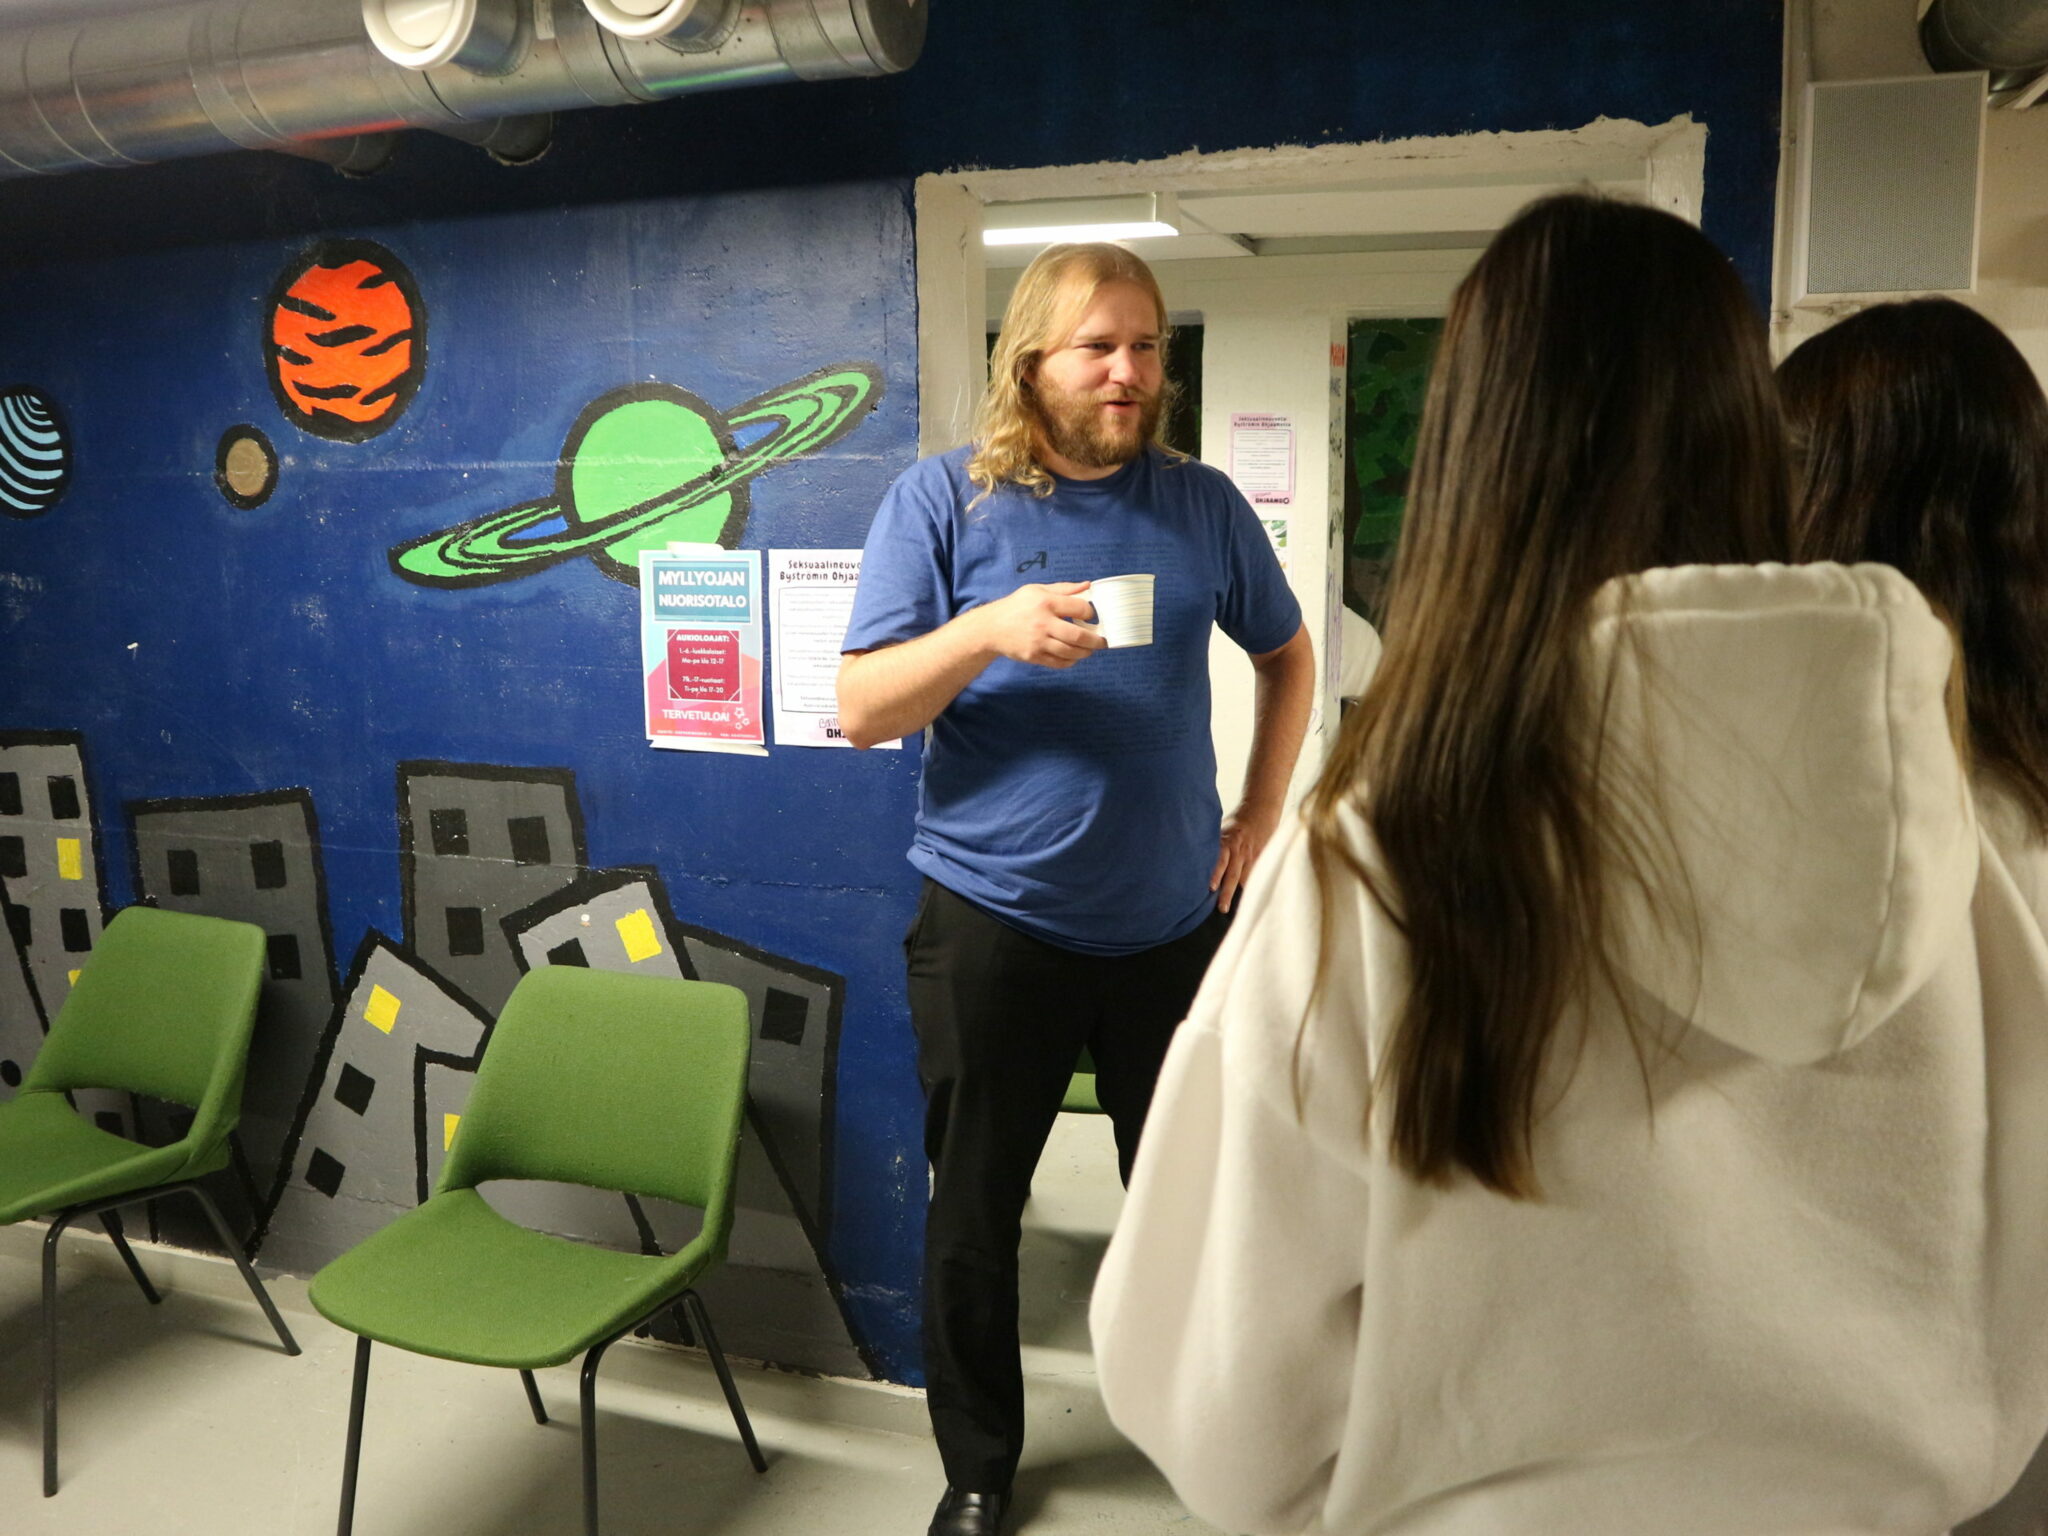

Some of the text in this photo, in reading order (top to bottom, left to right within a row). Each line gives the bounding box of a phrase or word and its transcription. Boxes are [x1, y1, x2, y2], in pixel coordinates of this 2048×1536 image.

[658, 570, 745, 587] MYLLYOJAN
[658, 594, 747, 608] NUORISOTALO
[676, 634, 730, 643] AUKIOLOAJAT:
[662, 709, 730, 722] TERVETULOA!
[826, 729, 847, 738] OH
